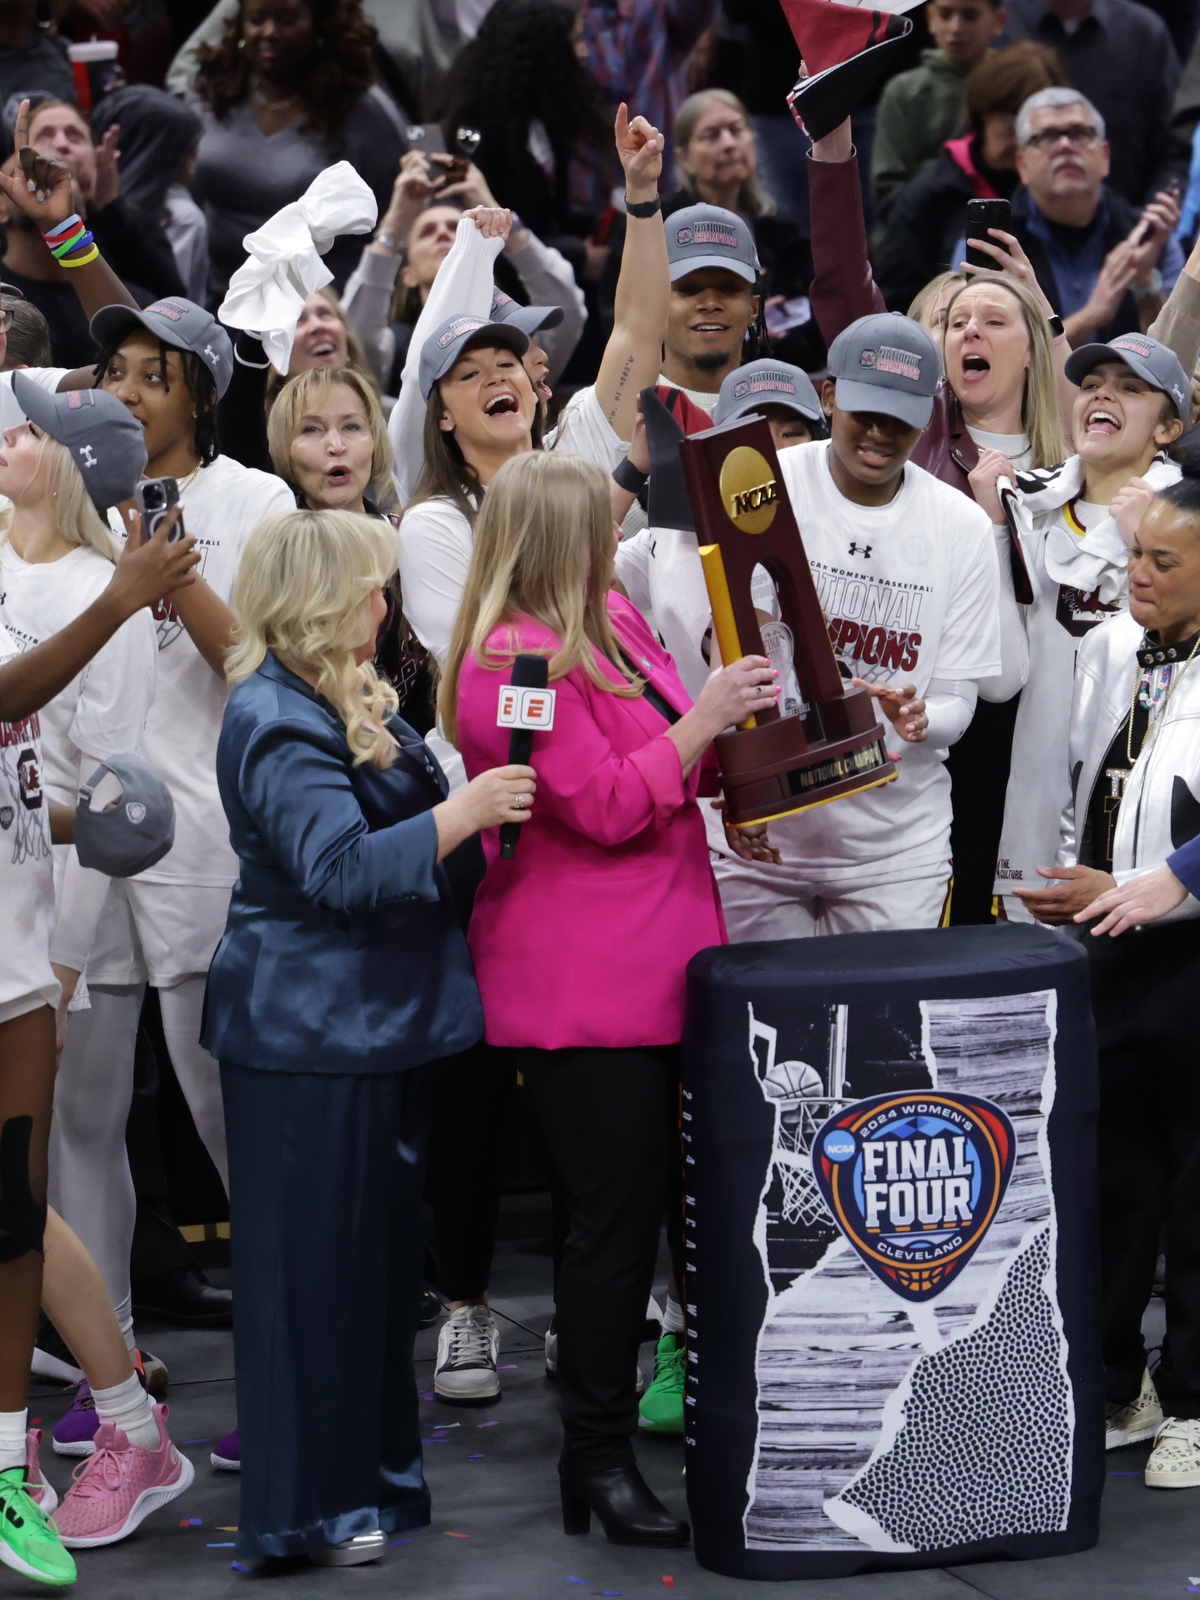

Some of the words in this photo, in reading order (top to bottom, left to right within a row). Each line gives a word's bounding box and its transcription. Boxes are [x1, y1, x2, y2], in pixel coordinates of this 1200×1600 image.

[731, 480, 777, 519] NCAA
[830, 565, 875, 582] WOMEN'S
[878, 577, 934, 593] BASKETBALL
[800, 760, 844, 789] NATIONAL
[682, 1089, 696, 1166] 2024
[860, 1109, 898, 1138] 2024
[901, 1104, 973, 1132] WOMEN'S
[827, 1144, 855, 1154] NCAA
[862, 1136, 972, 1182] FINAL
[864, 1177, 973, 1228] FOUR
[685, 1194, 697, 1273] NCAA
[876, 1235, 963, 1261] CLEVELAND
[685, 1303, 699, 1447] WOMEN'S
